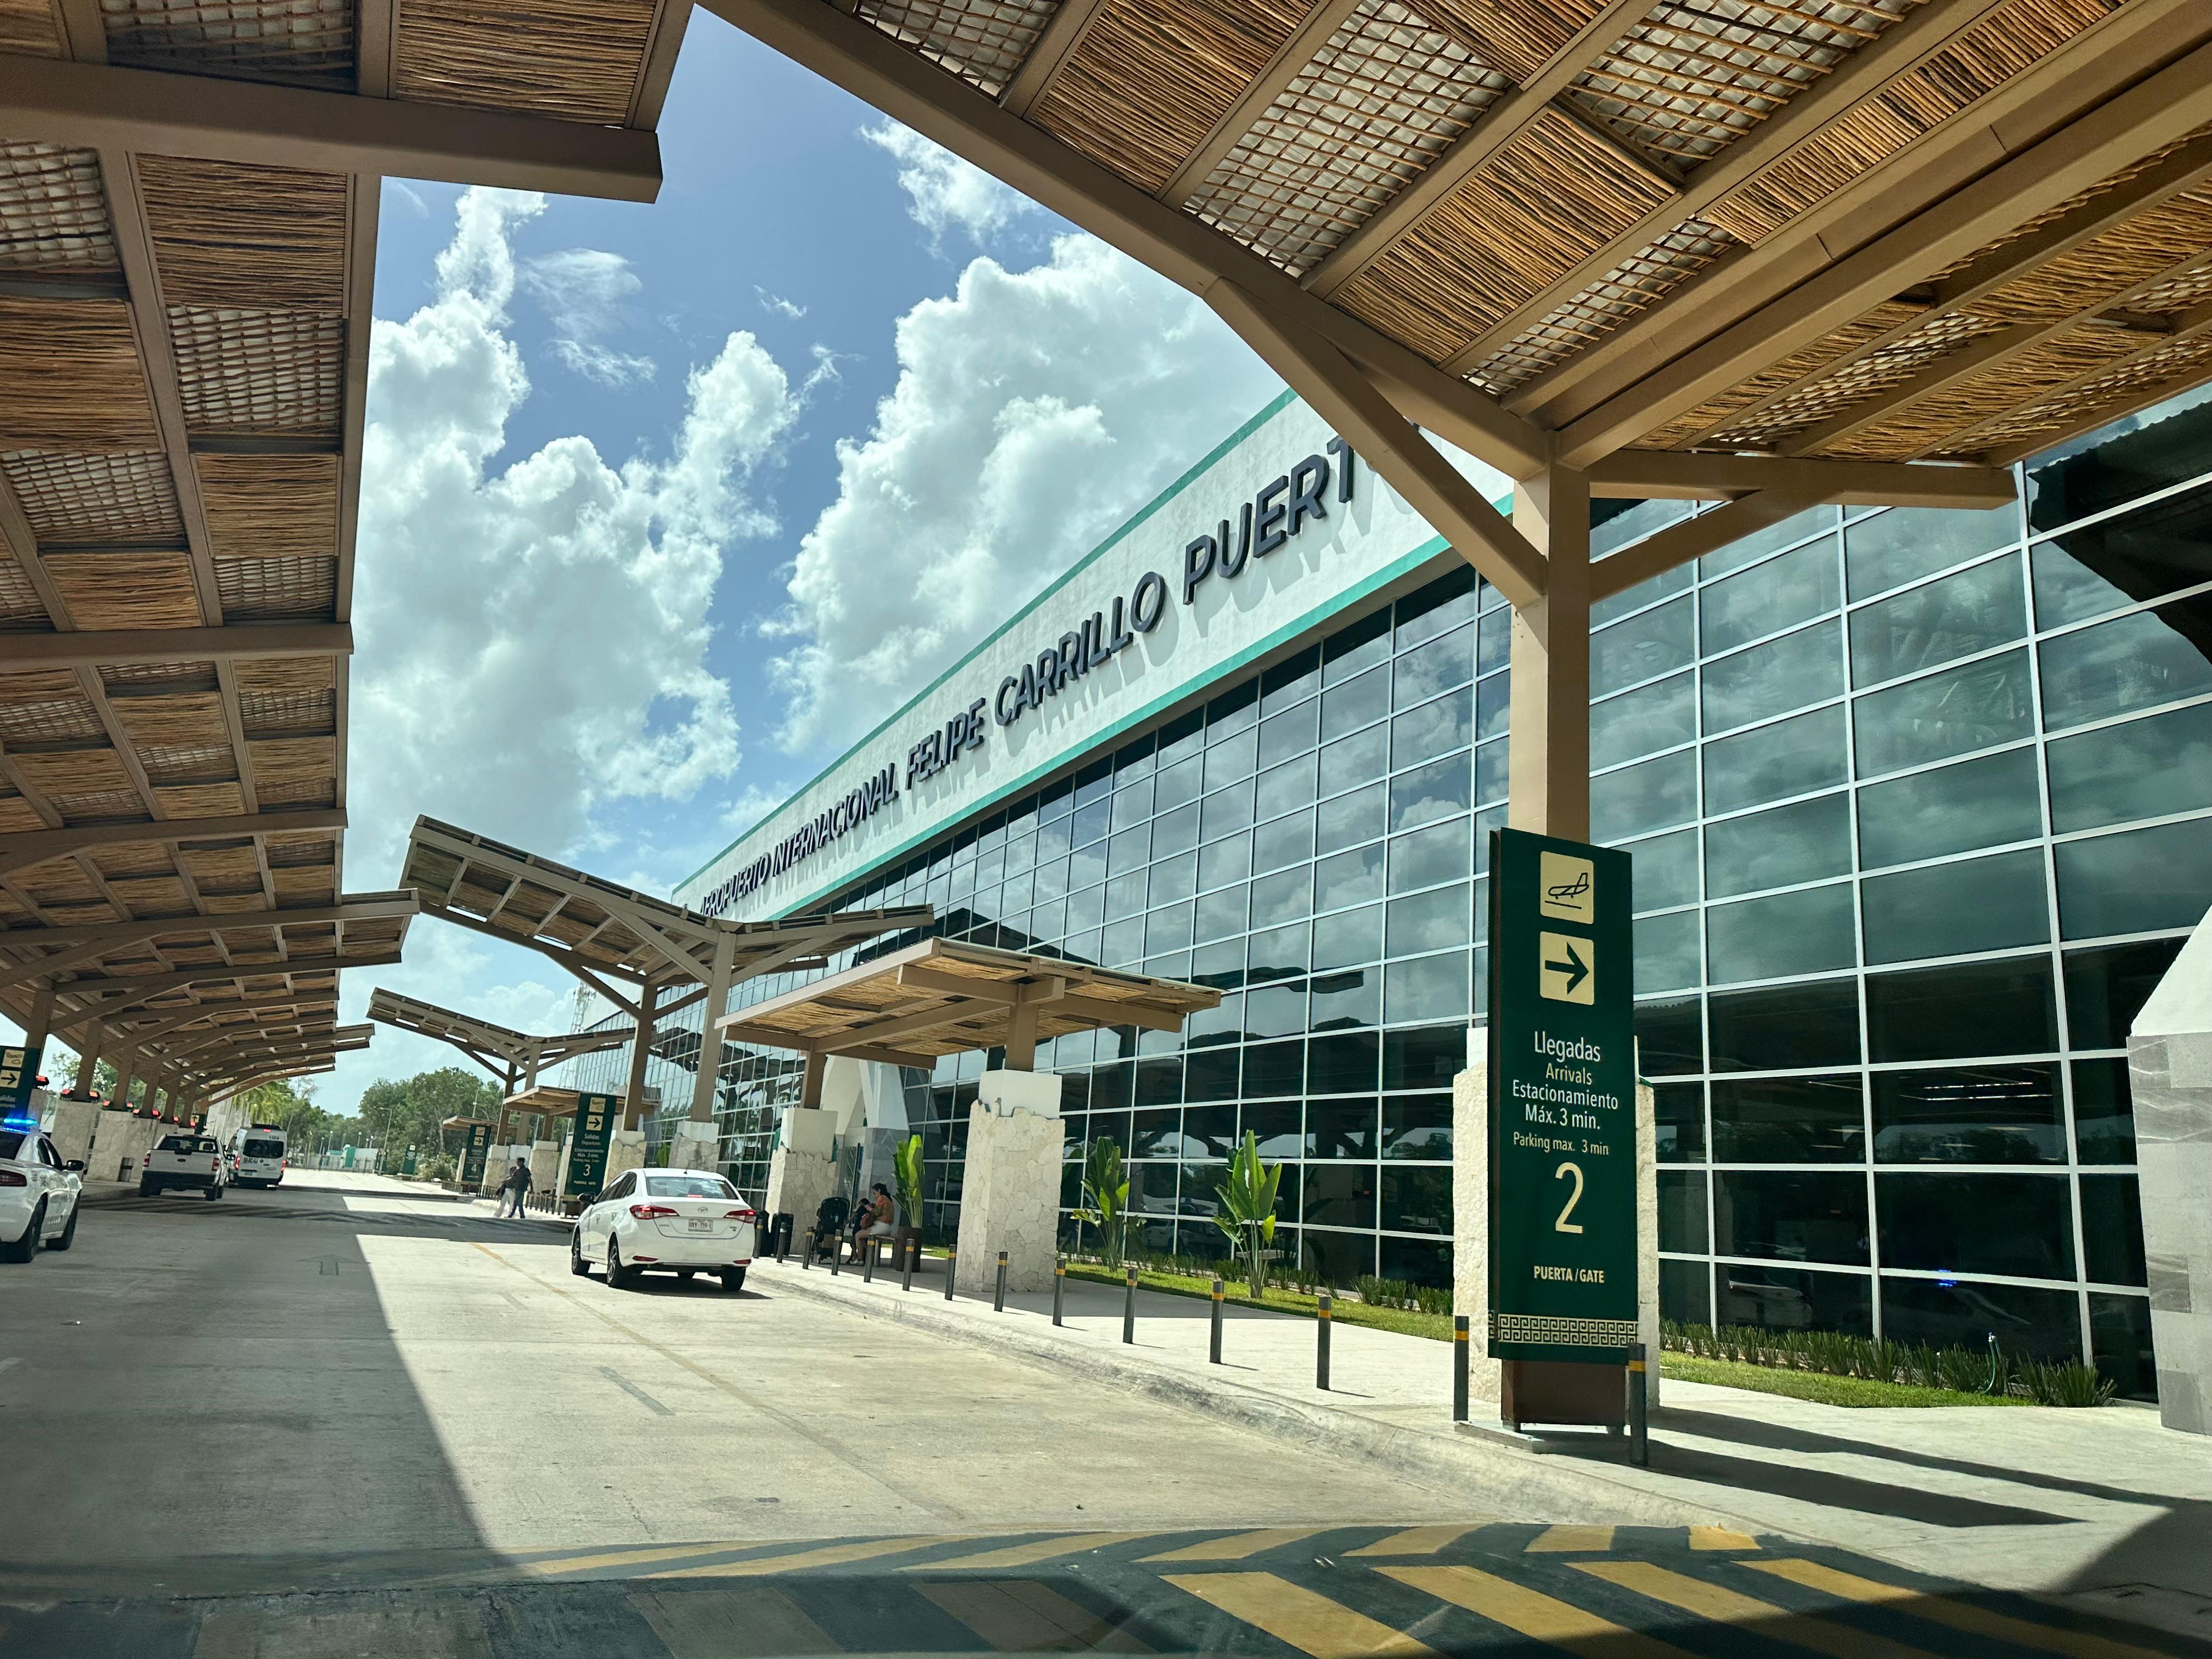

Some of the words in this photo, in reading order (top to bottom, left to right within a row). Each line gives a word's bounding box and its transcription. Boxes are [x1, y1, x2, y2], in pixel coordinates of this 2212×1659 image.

[700, 852, 771, 917] AEROPUERTO
[772, 762, 899, 877] INTERNACIONAL
[905, 697, 986, 791] FELIPE
[995, 571, 1166, 727] CARRILLO
[1183, 428, 1380, 605] PUERT
[1534, 1031, 1601, 1063] Llegadas
[1545, 1063, 1593, 1086] Arrivals
[1513, 1079, 1618, 1110] Estacionamiento
[1525, 1103, 1557, 1124] Máx.
[1560, 1108, 1568, 1126] 3
[1572, 1110, 1600, 1130] min.
[1513, 1131, 1550, 1153] Parking
[1553, 1139, 1576, 1152] max.
[1581, 1139, 1588, 1153] 3
[1590, 1142, 1609, 1155] min
[583, 1164, 591, 1176] 3
[1555, 1162, 1584, 1234] 2
[1533, 1265, 1573, 1282] PUERTA
